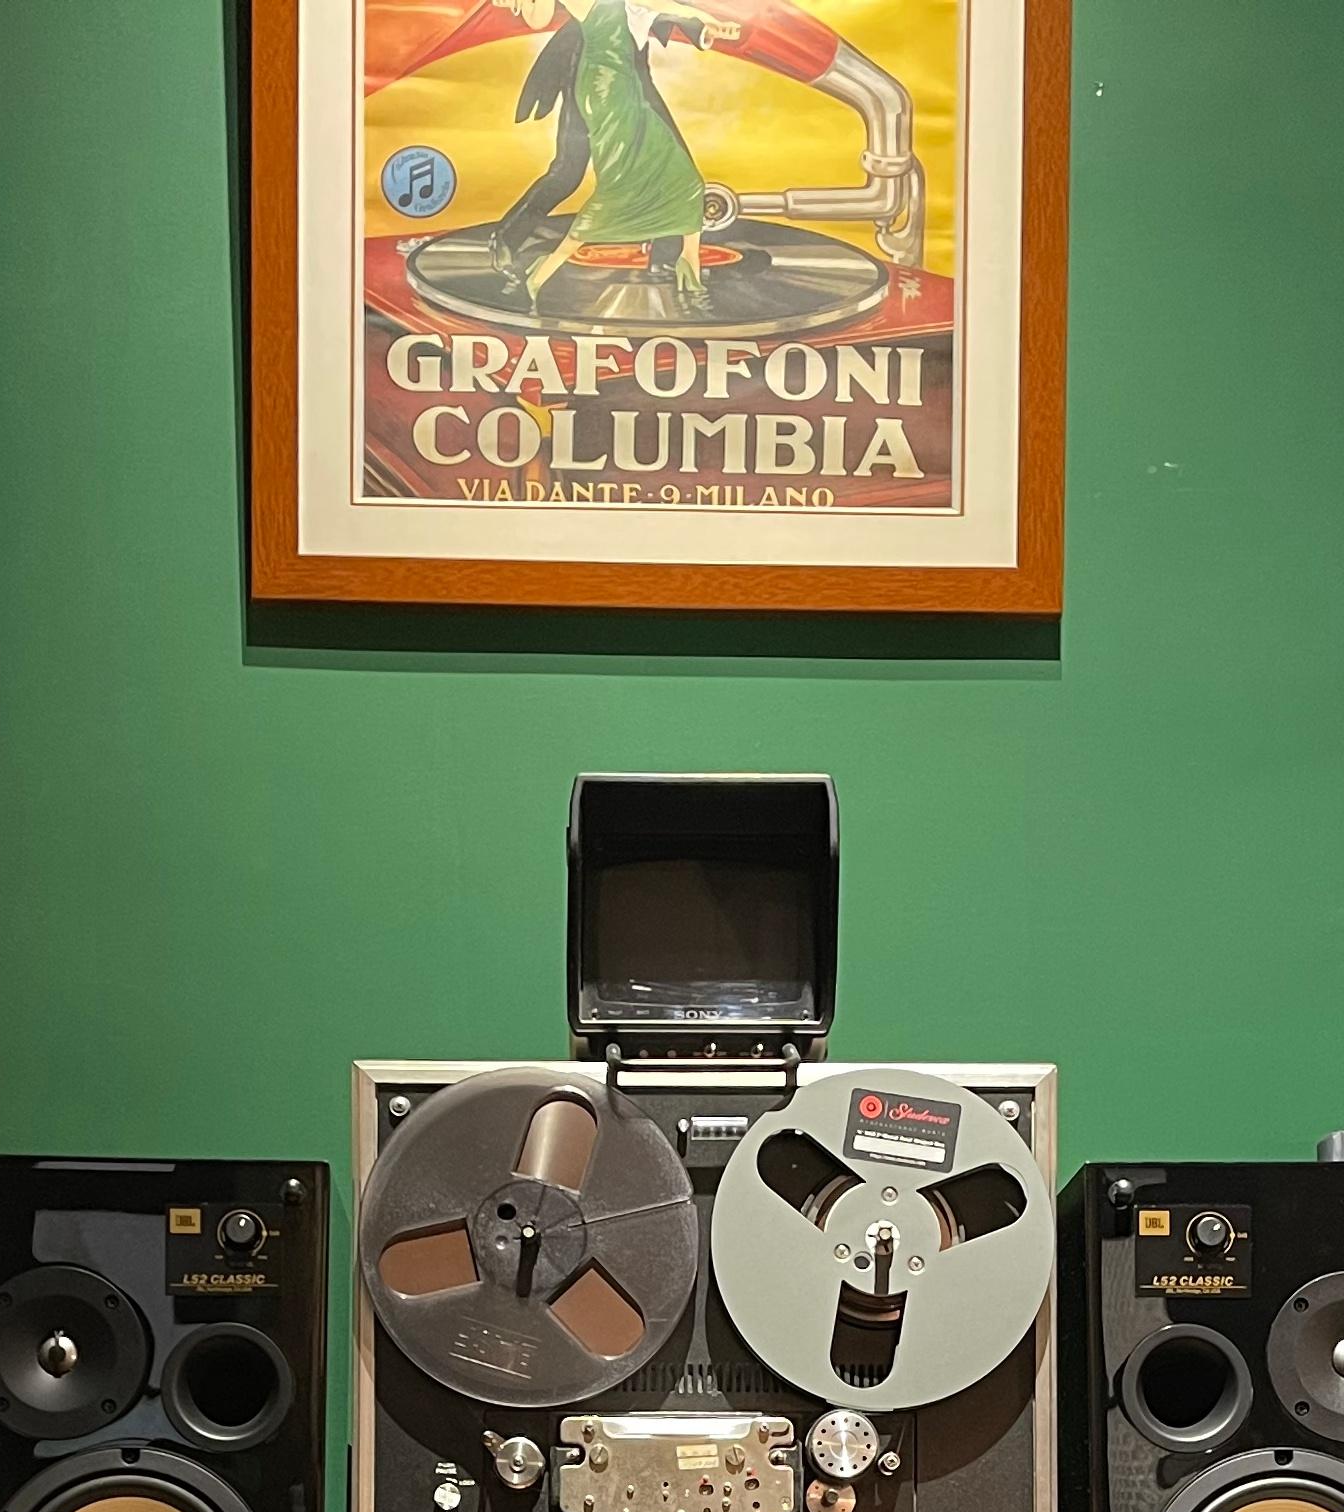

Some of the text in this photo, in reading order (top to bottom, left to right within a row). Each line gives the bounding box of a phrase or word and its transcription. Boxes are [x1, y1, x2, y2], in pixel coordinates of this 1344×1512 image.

[385, 333, 924, 407] GRAFOFONI
[412, 405, 925, 479] COLUMBIA
[457, 478, 513, 502] VIA
[673, 1009, 723, 1020] SONY
[210, 1274, 266, 1285] CLASSIC
[1152, 1275, 1234, 1287] L52 CLASSIC
